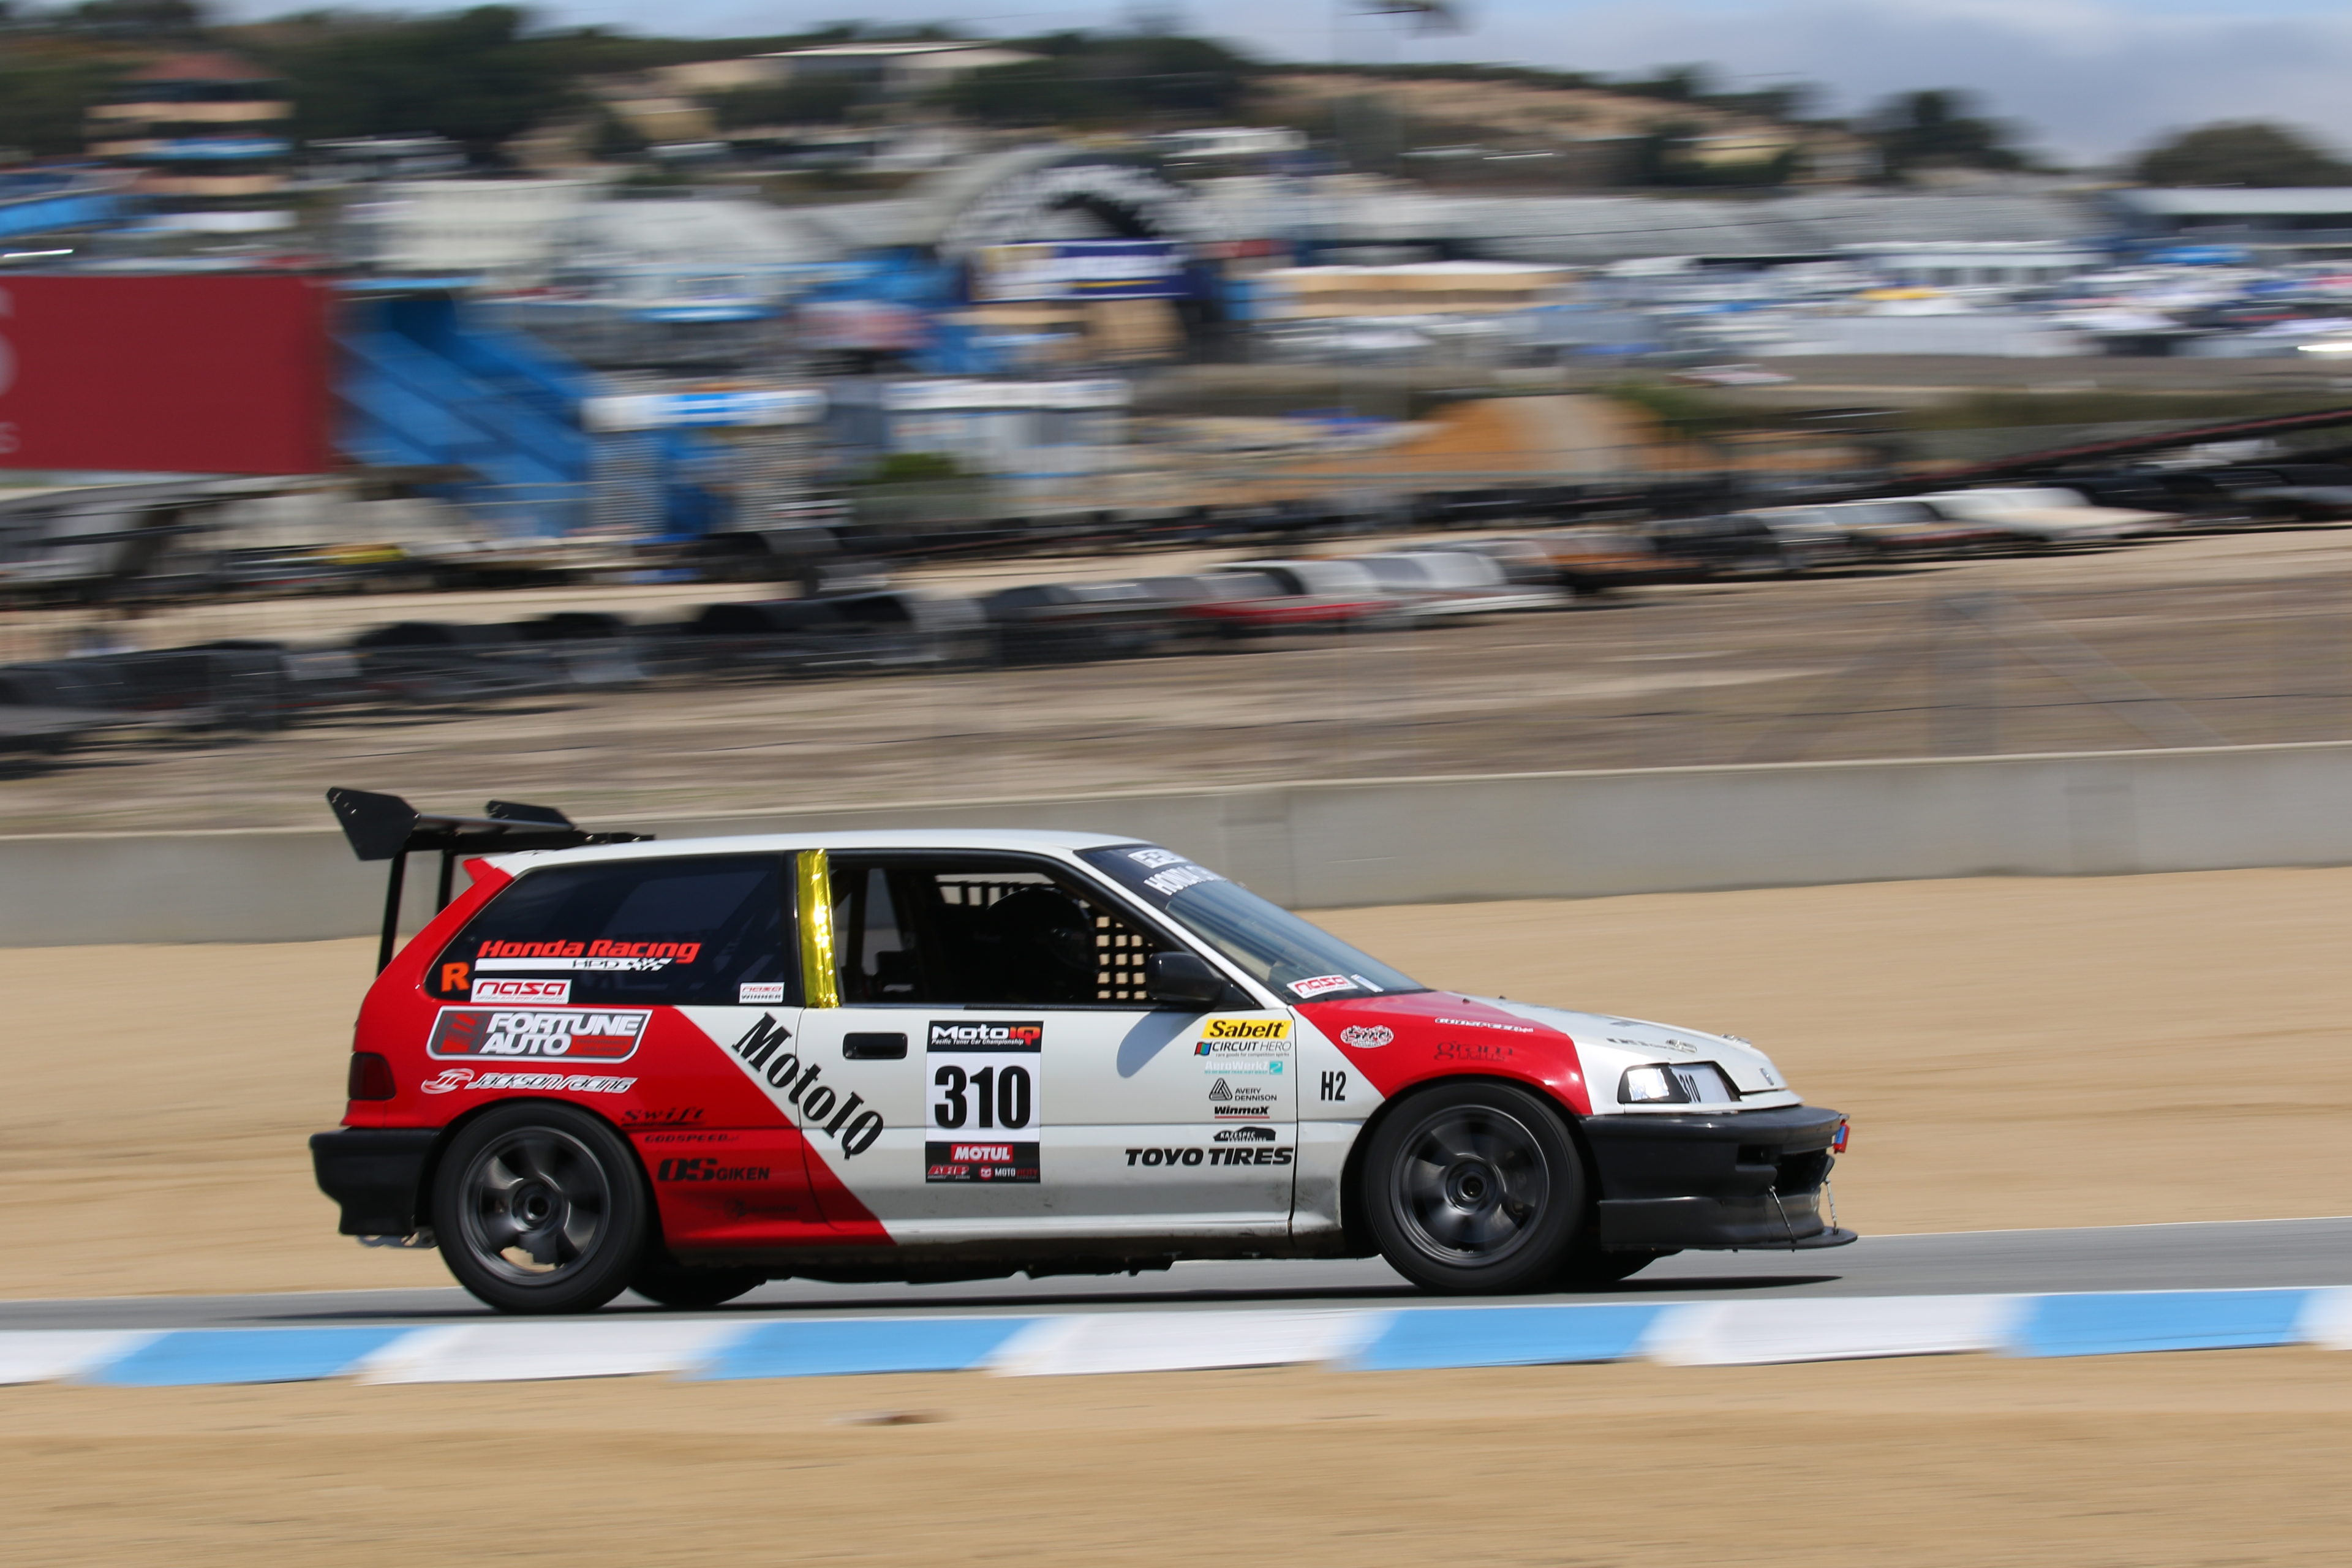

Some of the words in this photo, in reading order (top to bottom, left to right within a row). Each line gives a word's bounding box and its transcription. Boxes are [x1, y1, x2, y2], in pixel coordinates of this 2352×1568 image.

[477, 940, 586, 958] Honda
[587, 940, 701, 963] Racing
[573, 959, 619, 969] HPD
[441, 962, 470, 992] R
[486, 1012, 643, 1036] FORTUNE
[1209, 1020, 1284, 1038] Sabelt
[479, 1033, 572, 1055] AUTO
[932, 1023, 1041, 1046] MotoIQ
[1212, 1041, 1259, 1052] CIRCUIT
[1260, 1041, 1292, 1052] HERO
[731, 1011, 884, 1161] MotoIQ
[1321, 1071, 1346, 1101] H2
[934, 1065, 1031, 1129] 310
[620, 1107, 705, 1122] Swift
[645, 1134, 728, 1143] GODSPEED
[954, 1147, 1010, 1161] MOTUL
[1125, 1147, 1204, 1166] TOYO
[1208, 1147, 1294, 1166] TIRES
[715, 1167, 770, 1181] GIKEN
